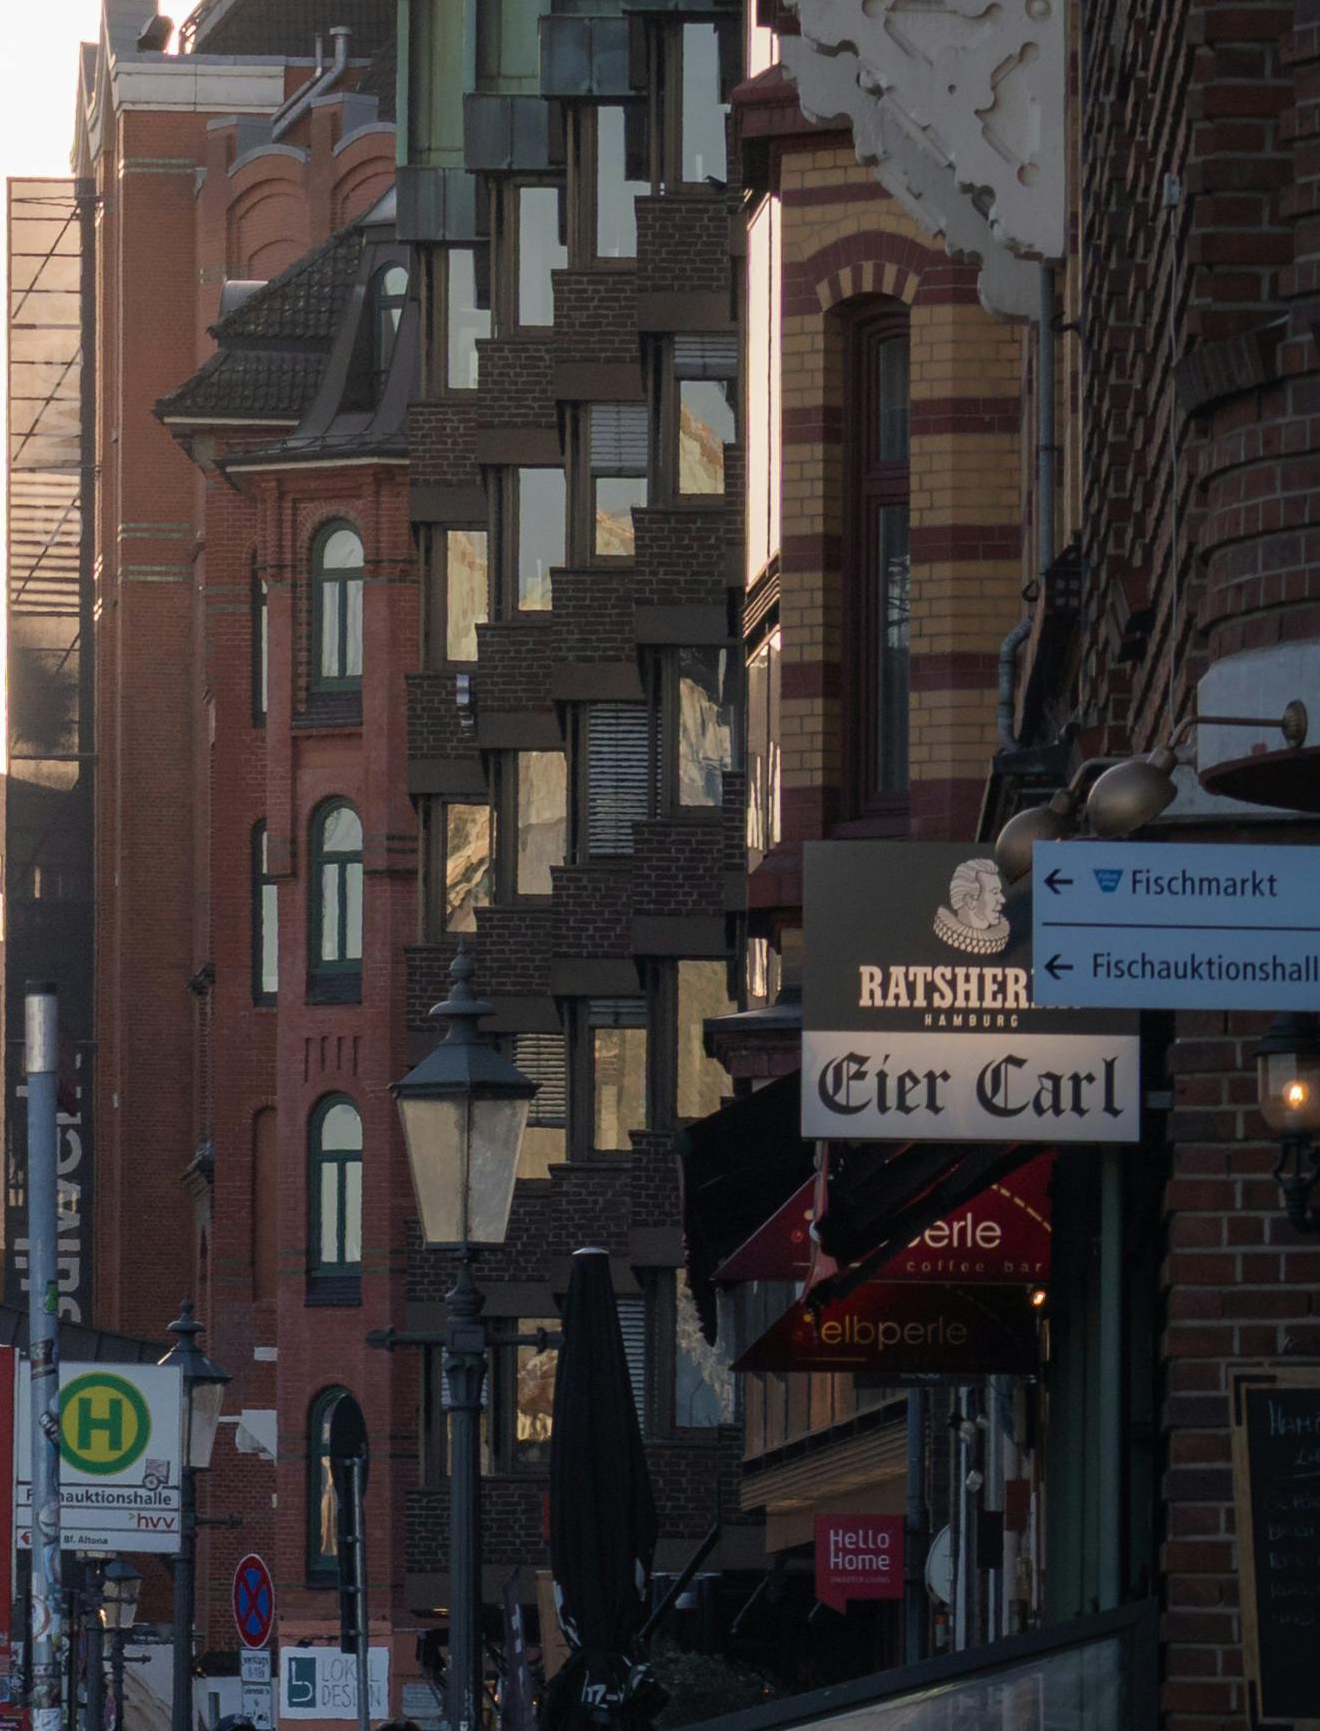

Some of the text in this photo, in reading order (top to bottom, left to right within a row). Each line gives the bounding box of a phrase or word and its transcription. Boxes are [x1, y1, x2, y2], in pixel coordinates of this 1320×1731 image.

[1131, 869, 1278, 897] Fischmarkt
[1093, 952, 1320, 982] Fischauktionshall
[859, 965, 1035, 1009] RATSHER
[924, 1014, 1019, 1028] HAMBURG
[818, 1052, 1124, 1118] Eier Carl
[820, 1315, 967, 1350] elbperle
[77, 1398, 123, 1452] H
[137, 1513, 176, 1529] hvv
[78, 1535, 108, 1545] Altona
[830, 1529, 890, 1549] Hello
[830, 1551, 890, 1570] Home
[322, 1659, 380, 1682] LOKL
[322, 1684, 381, 1708] DESIN
